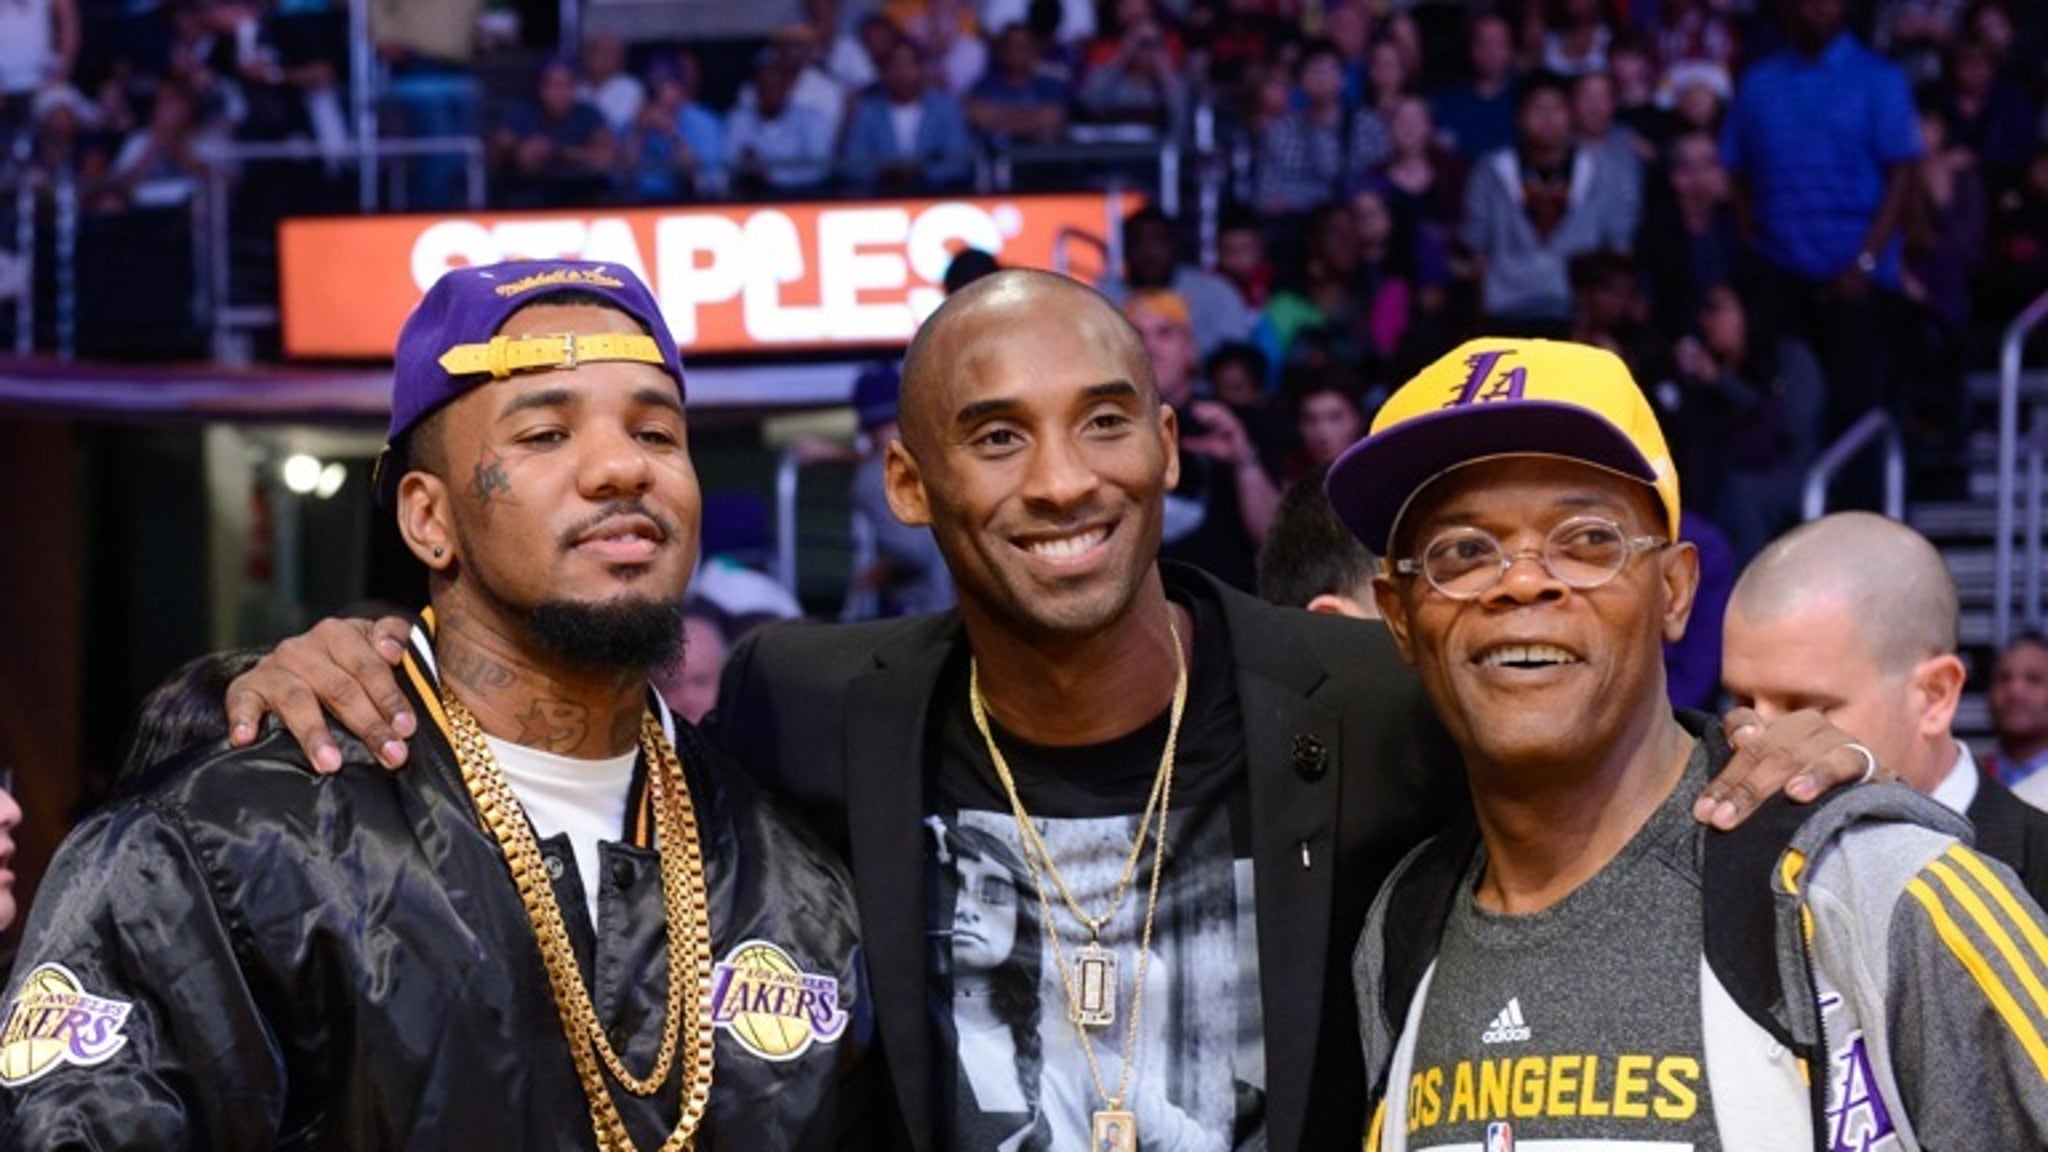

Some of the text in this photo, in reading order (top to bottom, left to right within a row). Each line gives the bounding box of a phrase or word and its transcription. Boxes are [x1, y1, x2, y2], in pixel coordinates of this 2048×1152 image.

[1443, 349, 1527, 408] LA
[713, 965, 848, 1036] LAKERS
[1482, 1026, 1531, 1044] adidas
[1404, 1055, 1699, 1135] OS ANGELES
